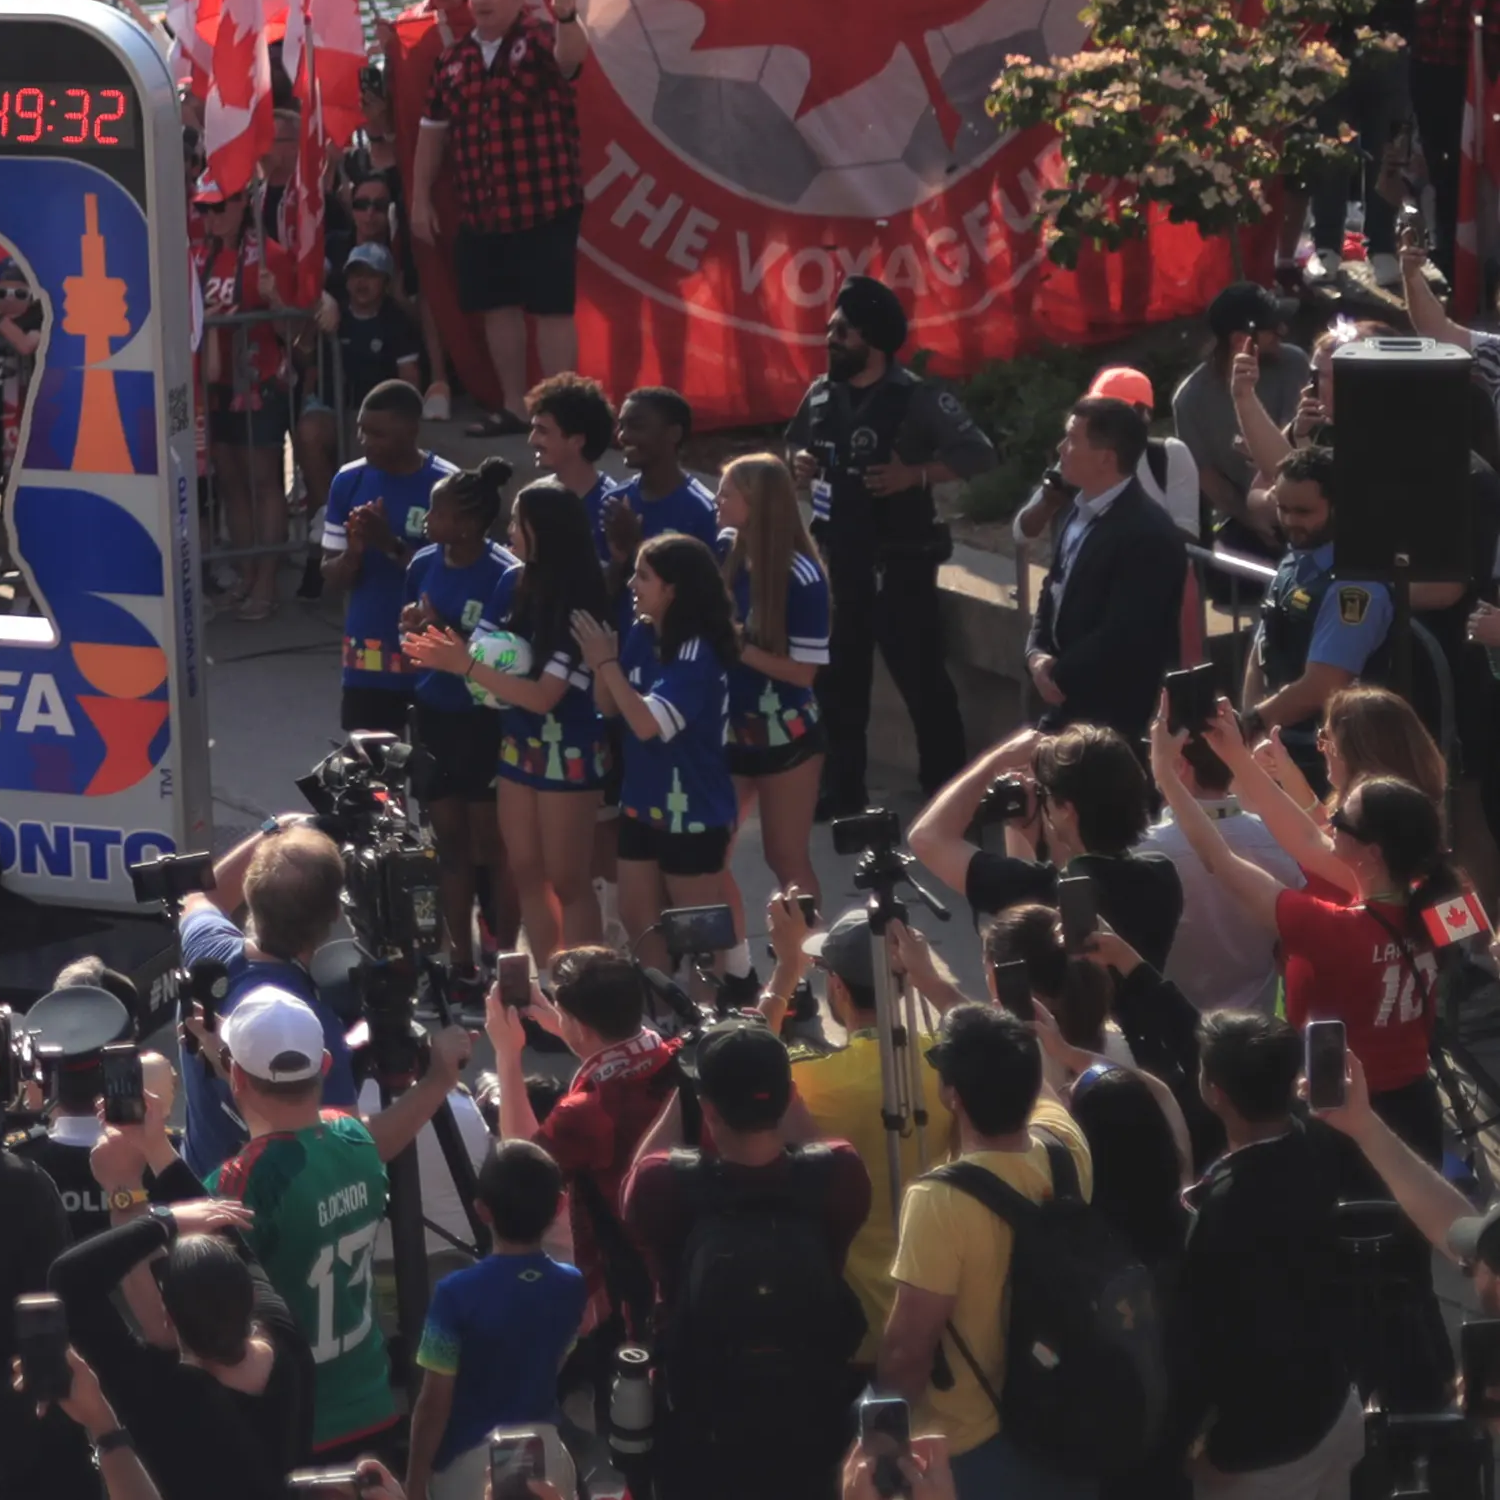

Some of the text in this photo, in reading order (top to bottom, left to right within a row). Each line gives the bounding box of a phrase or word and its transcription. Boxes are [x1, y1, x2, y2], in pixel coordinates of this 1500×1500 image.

[583, 139, 720, 272] THE
[177, 475, 198, 699] @FWC26TORNTO
[160, 767, 173, 800] TM
